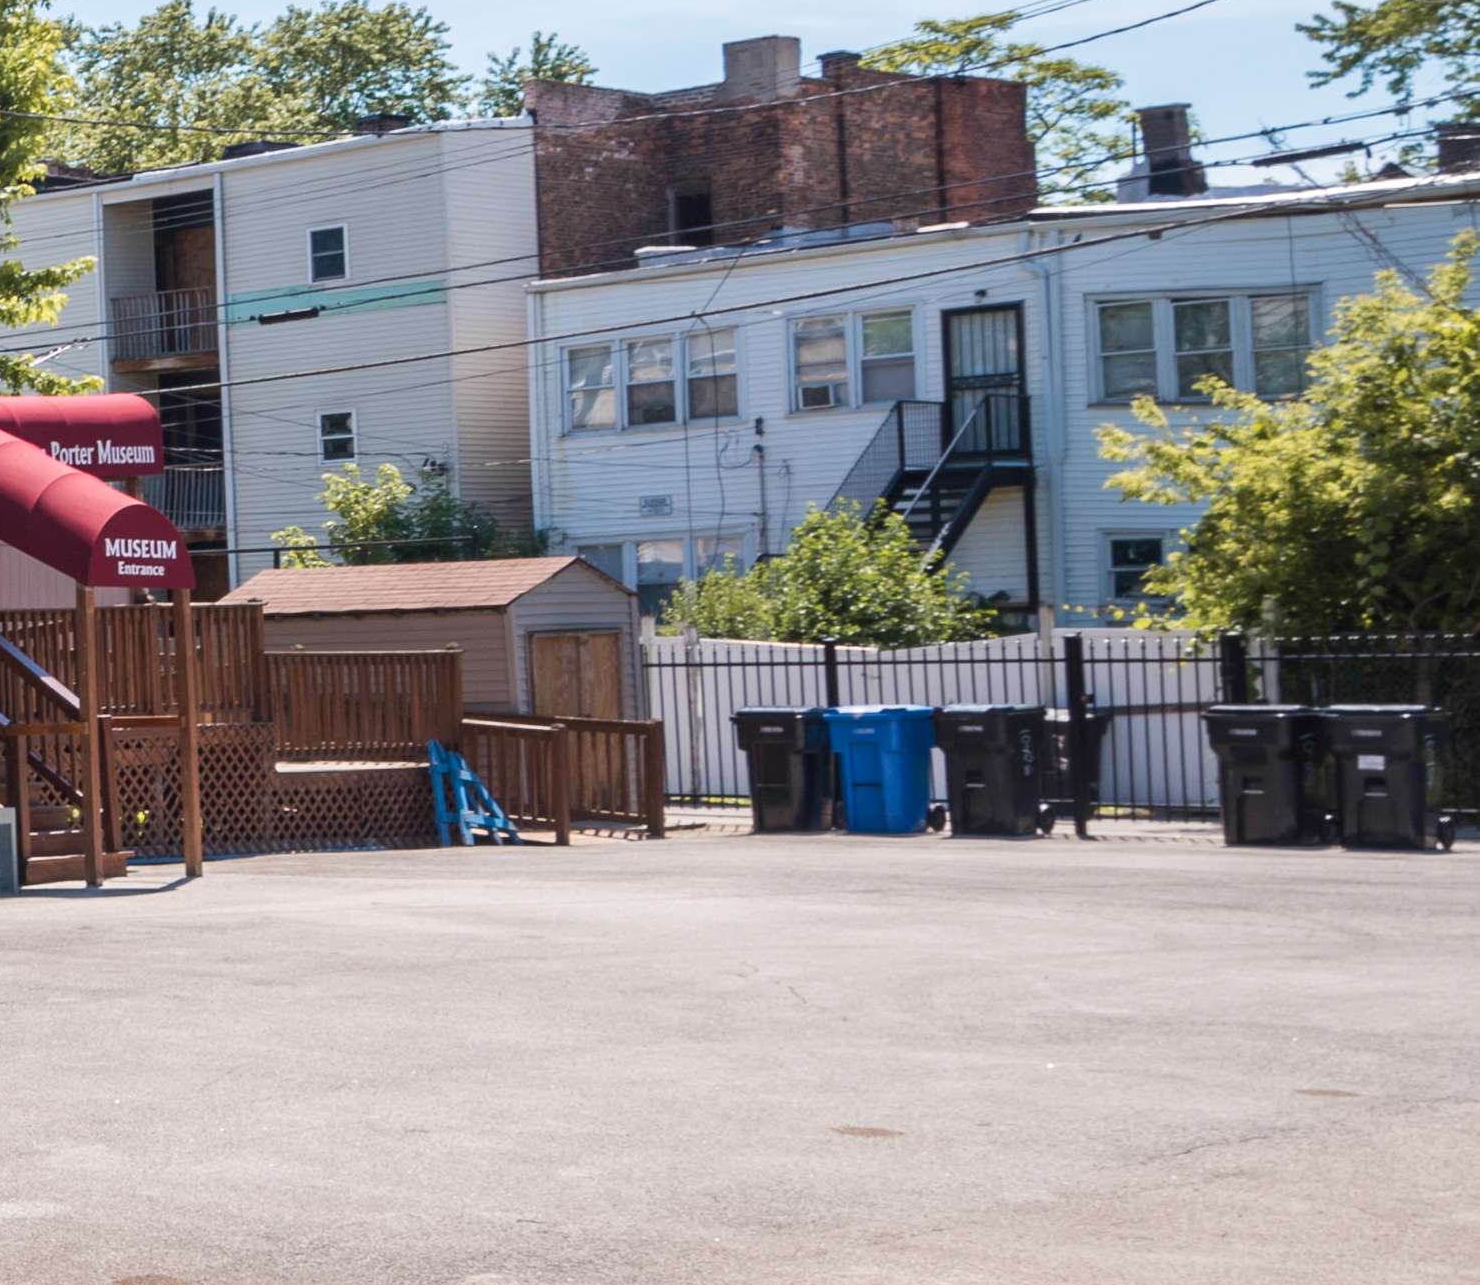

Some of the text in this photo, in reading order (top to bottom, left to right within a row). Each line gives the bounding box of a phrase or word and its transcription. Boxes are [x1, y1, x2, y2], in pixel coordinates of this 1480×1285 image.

[50, 439, 156, 465] Porter Museum
[104, 538, 177, 559] MUSEUM
[118, 561, 164, 576] Entrance
